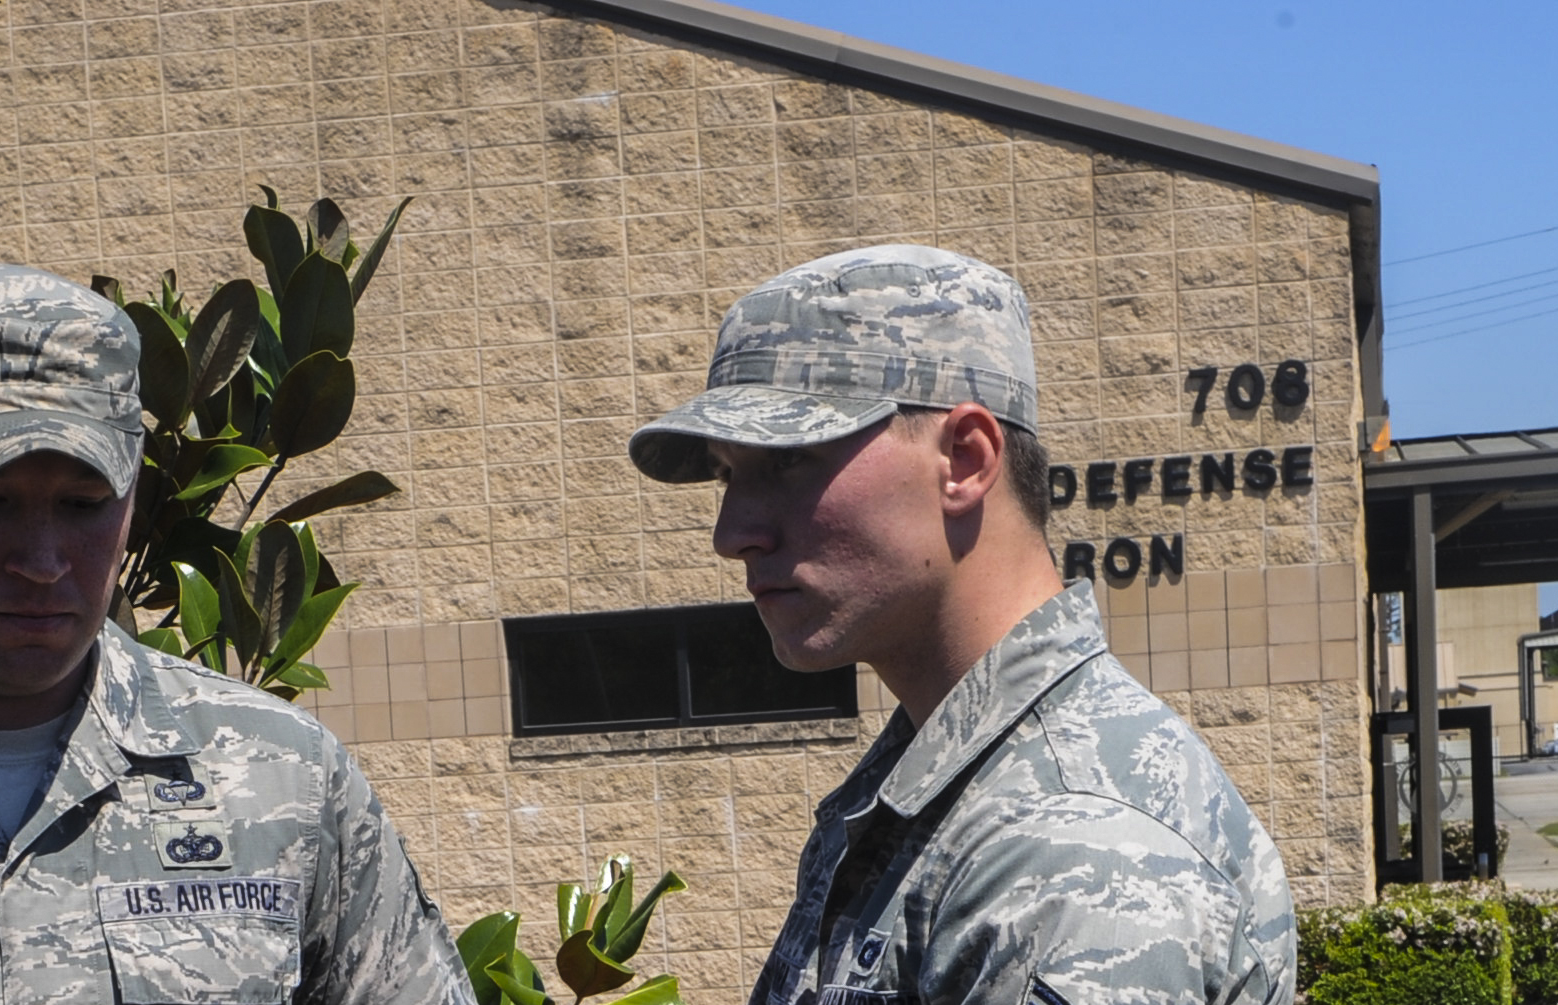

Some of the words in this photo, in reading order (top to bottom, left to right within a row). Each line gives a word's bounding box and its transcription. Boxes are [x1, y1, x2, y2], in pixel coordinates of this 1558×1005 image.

[1187, 360, 1310, 414] 708
[1048, 446, 1314, 506] DEFENSE
[1062, 533, 1184, 584] RON
[126, 886, 172, 915] U.S.
[177, 884, 216, 913] AIR
[218, 882, 283, 912] FORCE
